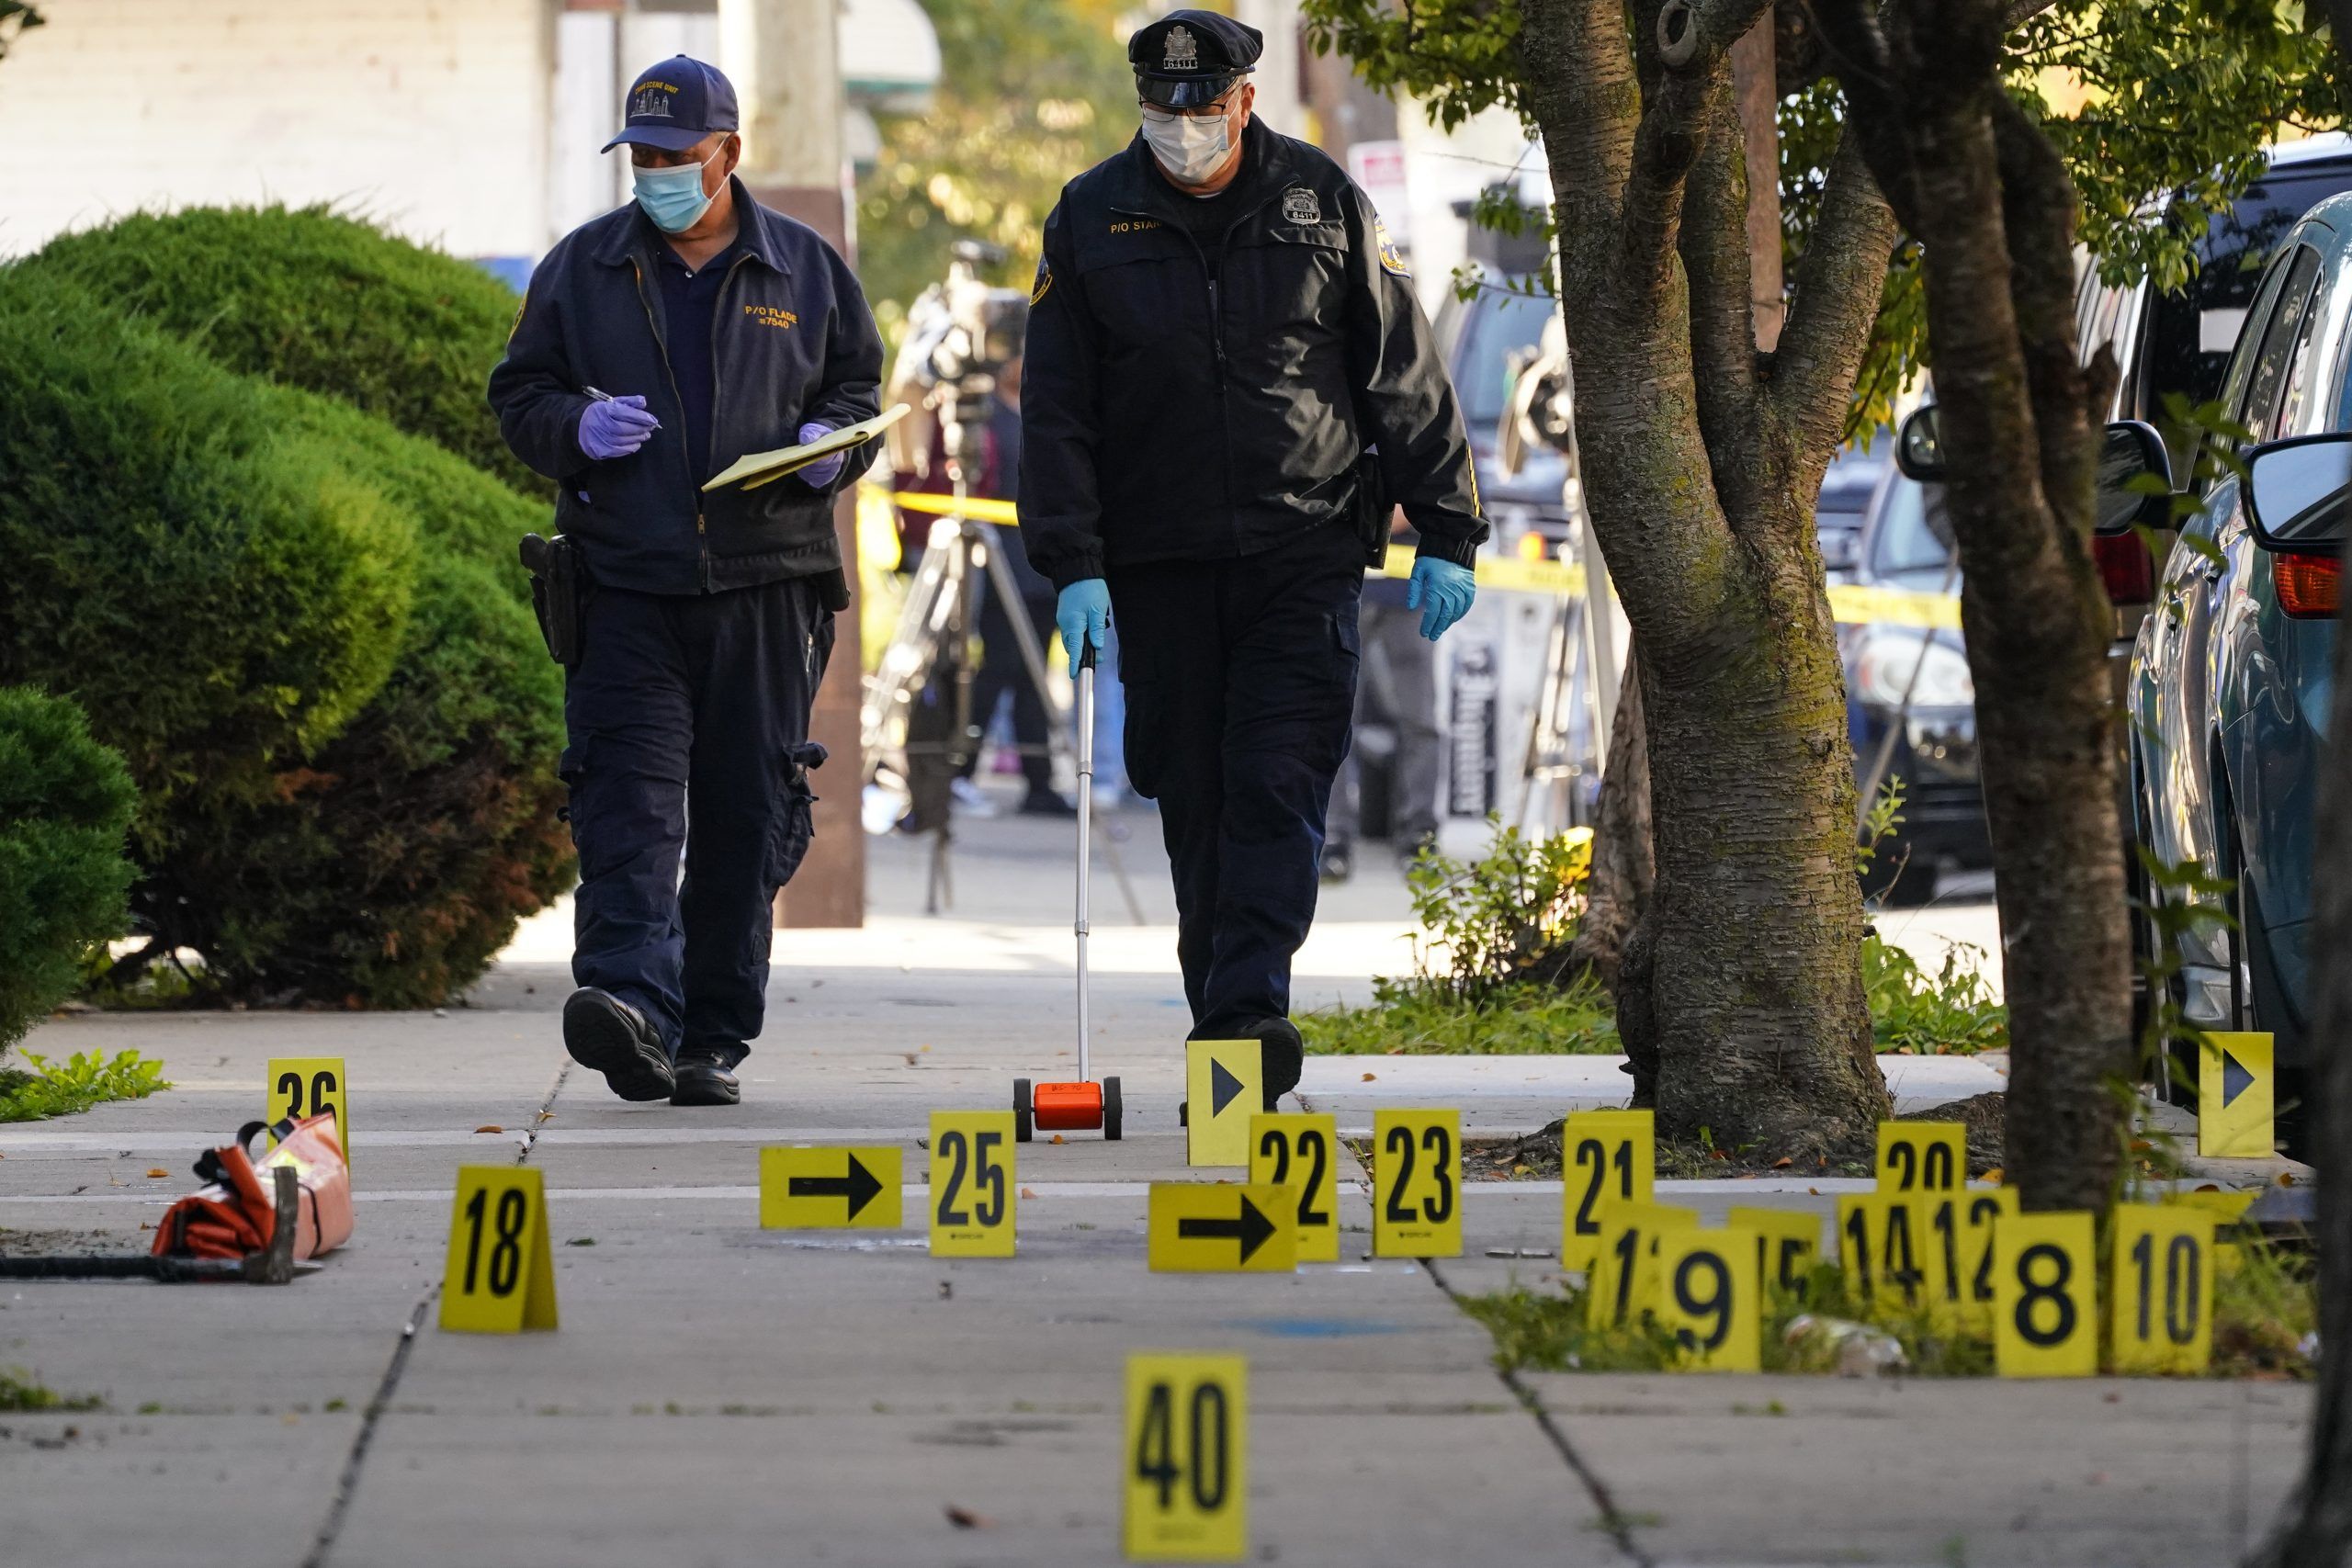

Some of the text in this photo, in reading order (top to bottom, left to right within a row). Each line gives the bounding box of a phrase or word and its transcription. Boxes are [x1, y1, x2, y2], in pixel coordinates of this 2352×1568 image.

[1111, 222, 1129, 233] P/O
[1292, 211, 1313, 220] 6411
[745, 305, 797, 323] P/O FLADE
[277, 1071, 336, 1126] 36
[938, 1131, 1004, 1226] 25
[1261, 1131, 1329, 1225] 22
[1386, 1126, 1453, 1223] 23
[1576, 1139, 1633, 1235] 21
[464, 1187, 526, 1298] 18
[1614, 1228, 1659, 1328] 1
[1847, 1205, 1924, 1304] 14
[1935, 1198, 2000, 1301] 12
[2132, 1234, 2199, 1344] 10
[1674, 1250, 1731, 1350] 9
[2015, 1243, 2076, 1346] 8
[1137, 1382, 1227, 1509] 40
